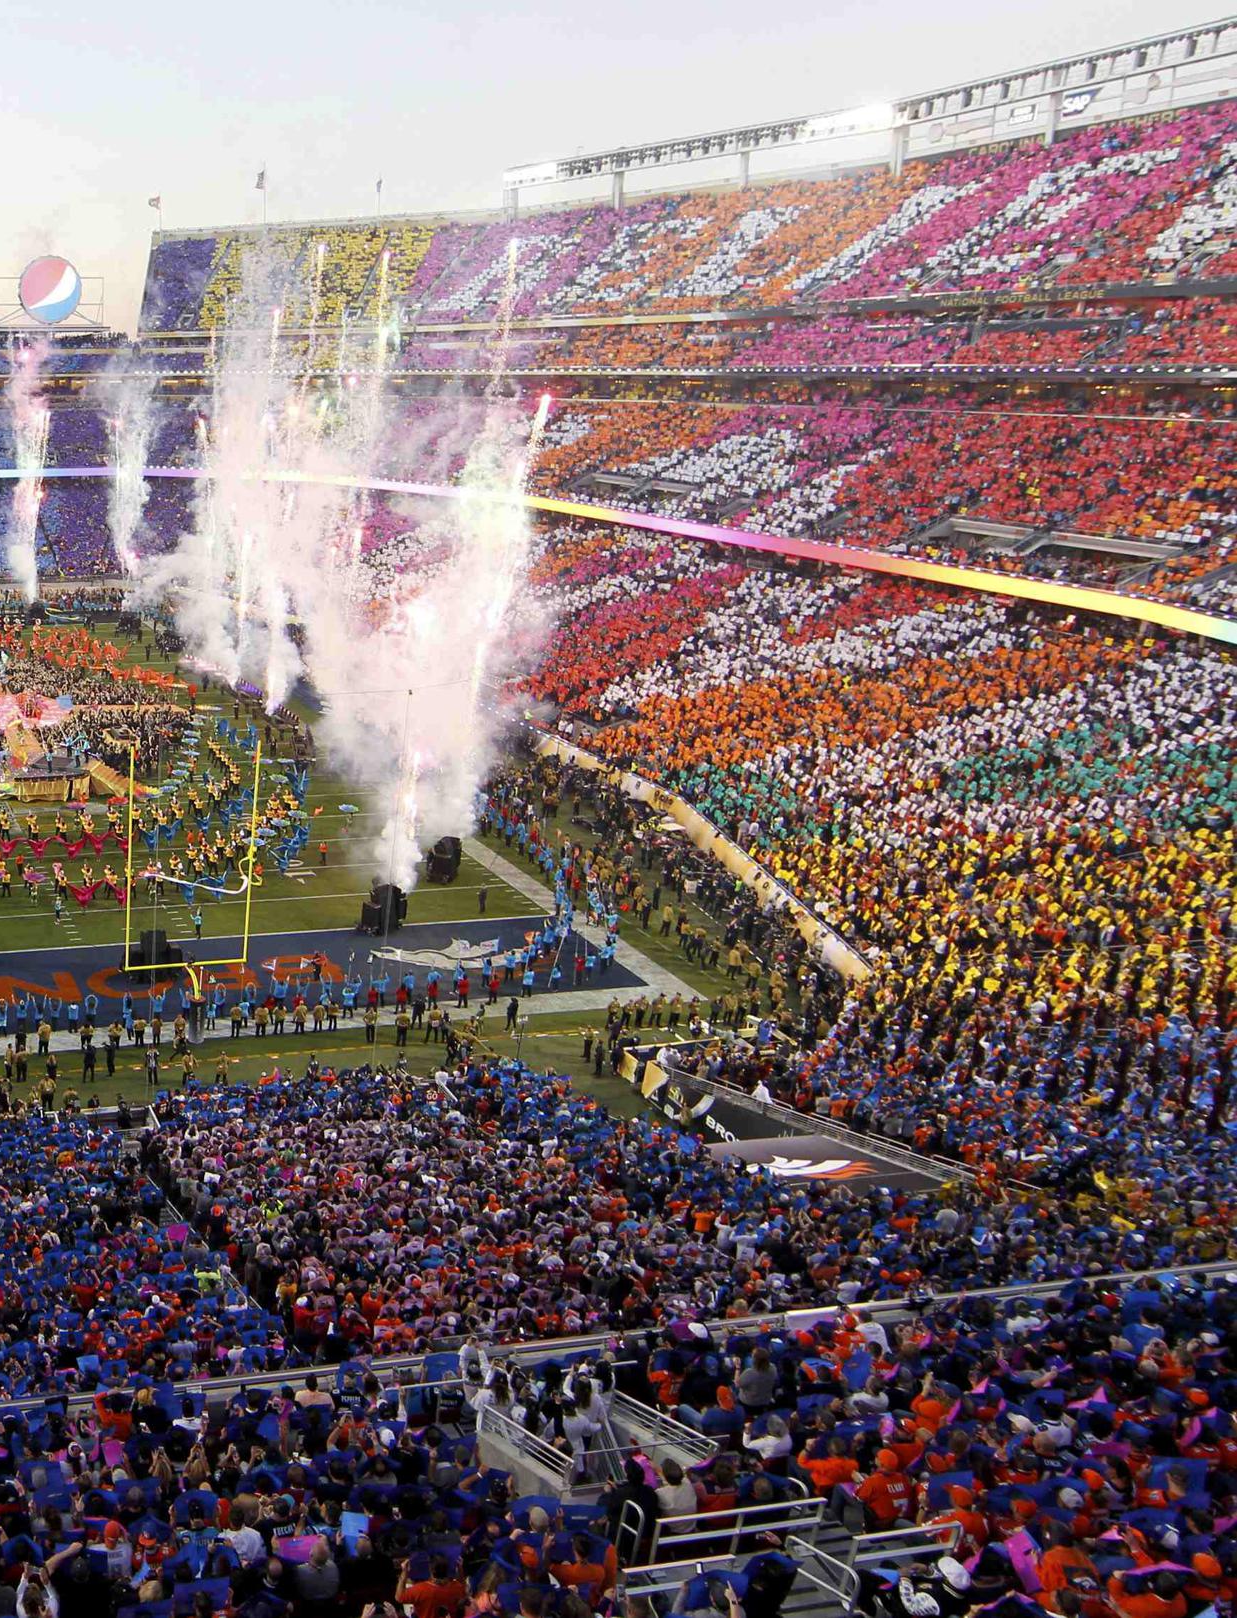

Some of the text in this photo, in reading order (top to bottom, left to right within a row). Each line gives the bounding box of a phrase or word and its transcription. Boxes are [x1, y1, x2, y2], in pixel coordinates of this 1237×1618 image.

[1062, 94, 1091, 113] SAP
[940, 289, 1105, 307] NATIONAL FOOTBALL LEAGUE
[705, 1114, 741, 1144] BRO
